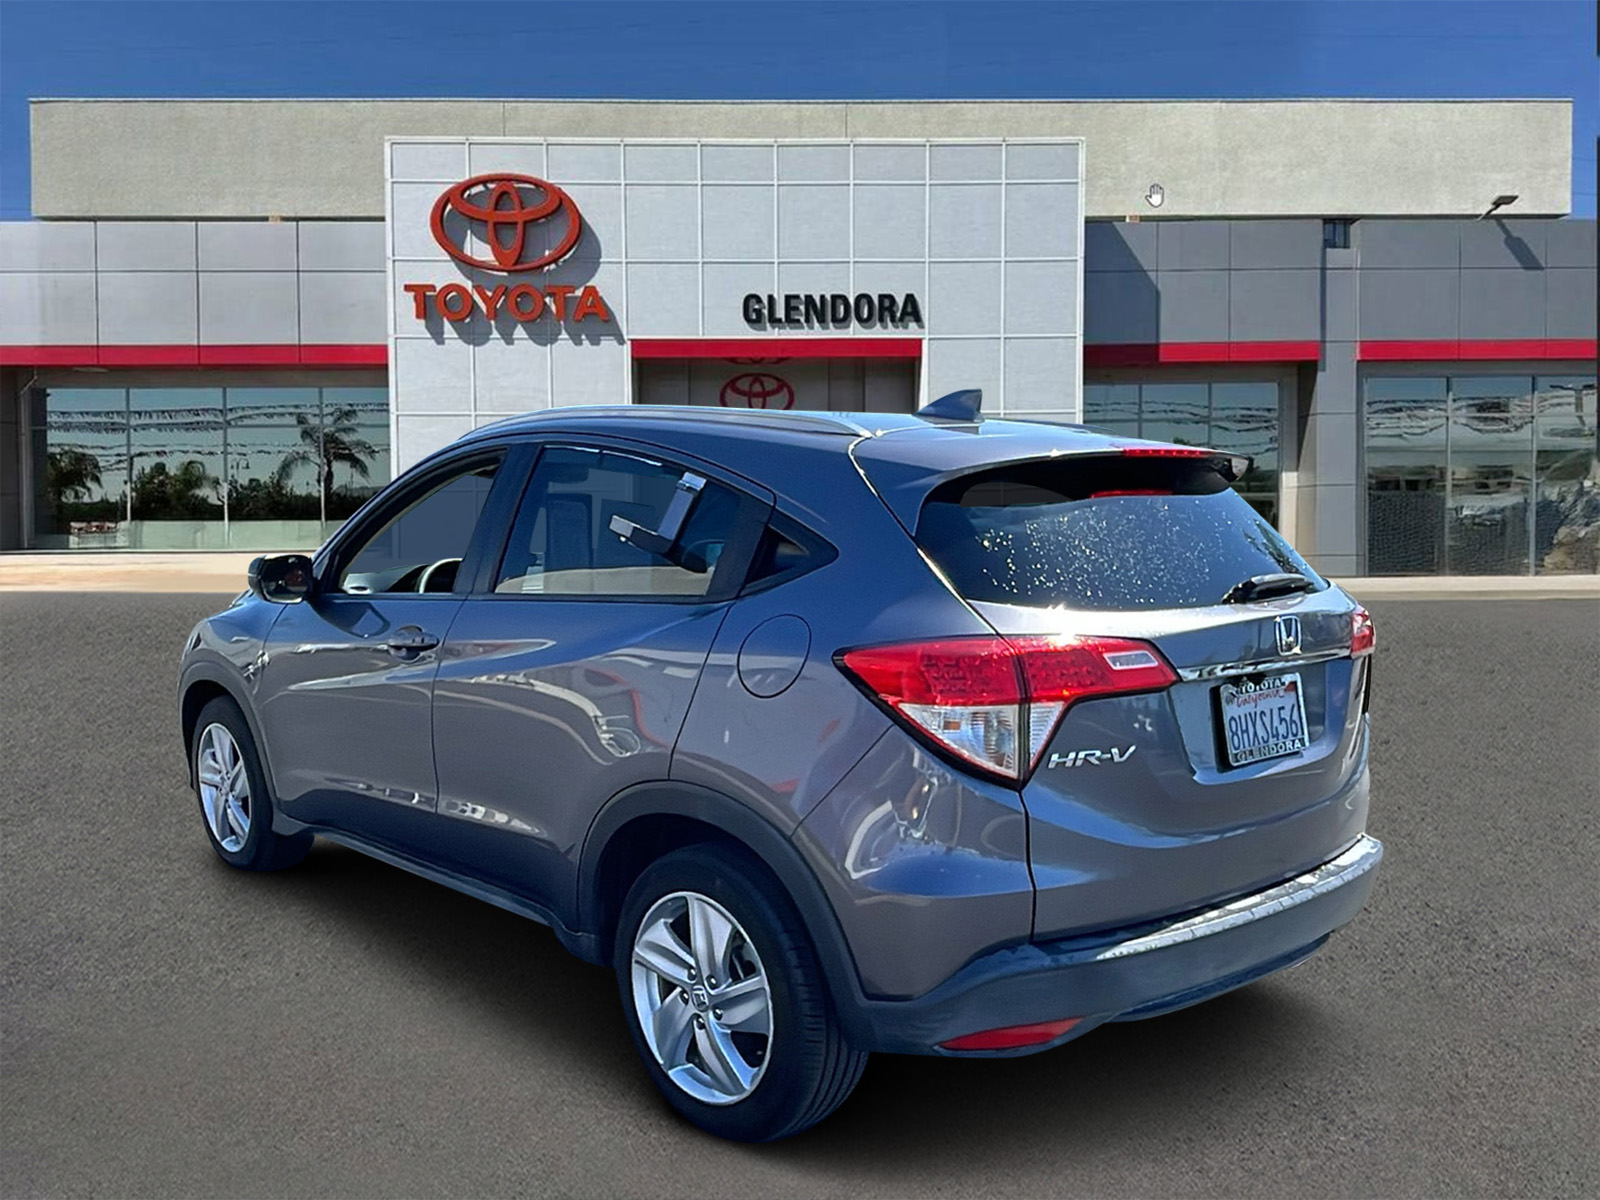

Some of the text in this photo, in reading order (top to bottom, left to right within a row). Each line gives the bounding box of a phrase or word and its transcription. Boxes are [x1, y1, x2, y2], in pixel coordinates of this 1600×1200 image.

[404, 283, 610, 322] TOYOTA
[742, 293, 923, 324] GLENDORA
[1228, 703, 1299, 751] 8HXS456
[1047, 745, 1136, 769] HR-V
[1237, 739, 1302, 761] GLENDORA
